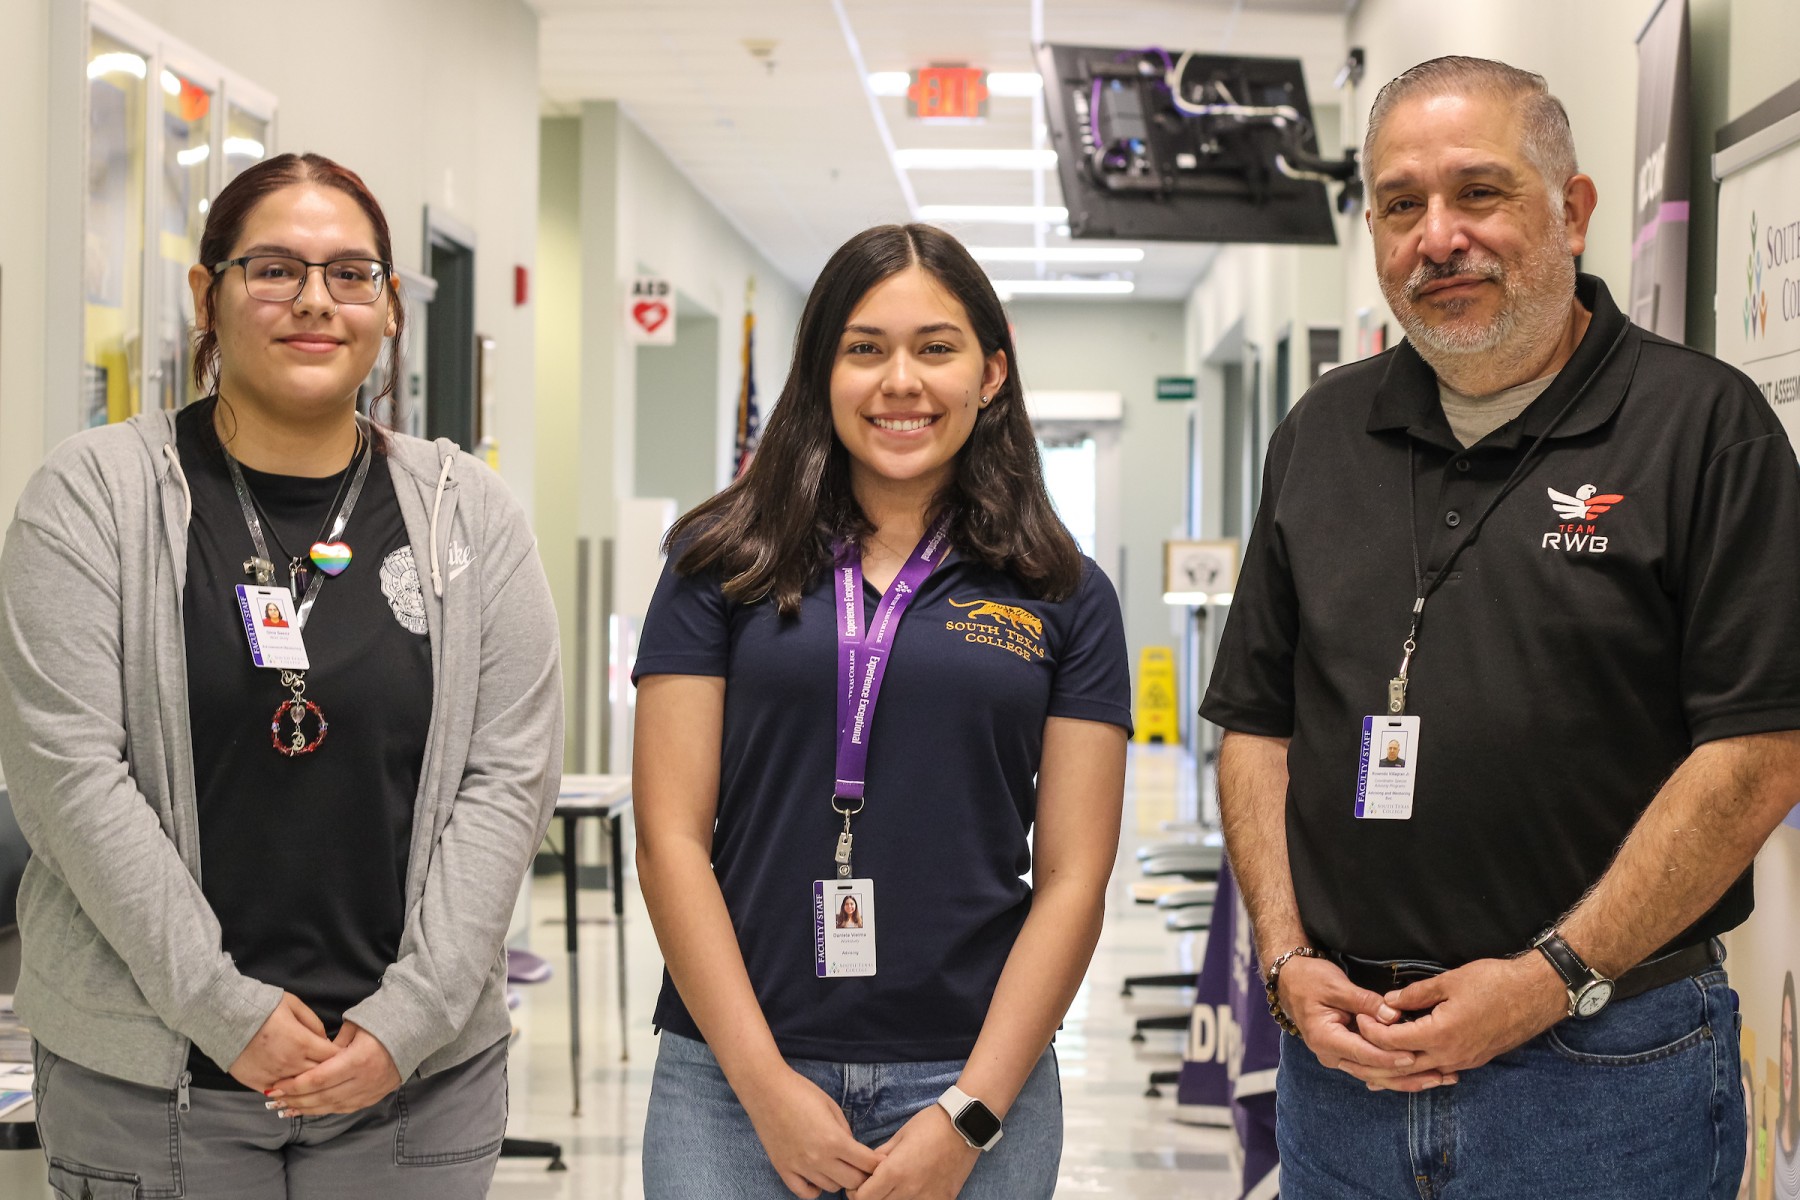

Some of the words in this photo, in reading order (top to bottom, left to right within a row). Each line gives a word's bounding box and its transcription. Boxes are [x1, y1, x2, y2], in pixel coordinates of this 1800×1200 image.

[918, 68, 981, 117] EXIT
[633, 281, 670, 296] AED
[1542, 532, 1609, 553] RWB
[1559, 524, 1596, 535] TEAM
[842, 568, 856, 600] Exceptional
[844, 600, 858, 637] Experience
[945, 620, 1000, 635] SOUTH
[1005, 628, 1045, 658] TEXAS
[965, 633, 1031, 661] COLLEGE
[861, 656, 881, 699] Experience
[852, 699, 870, 744] Exceptional
